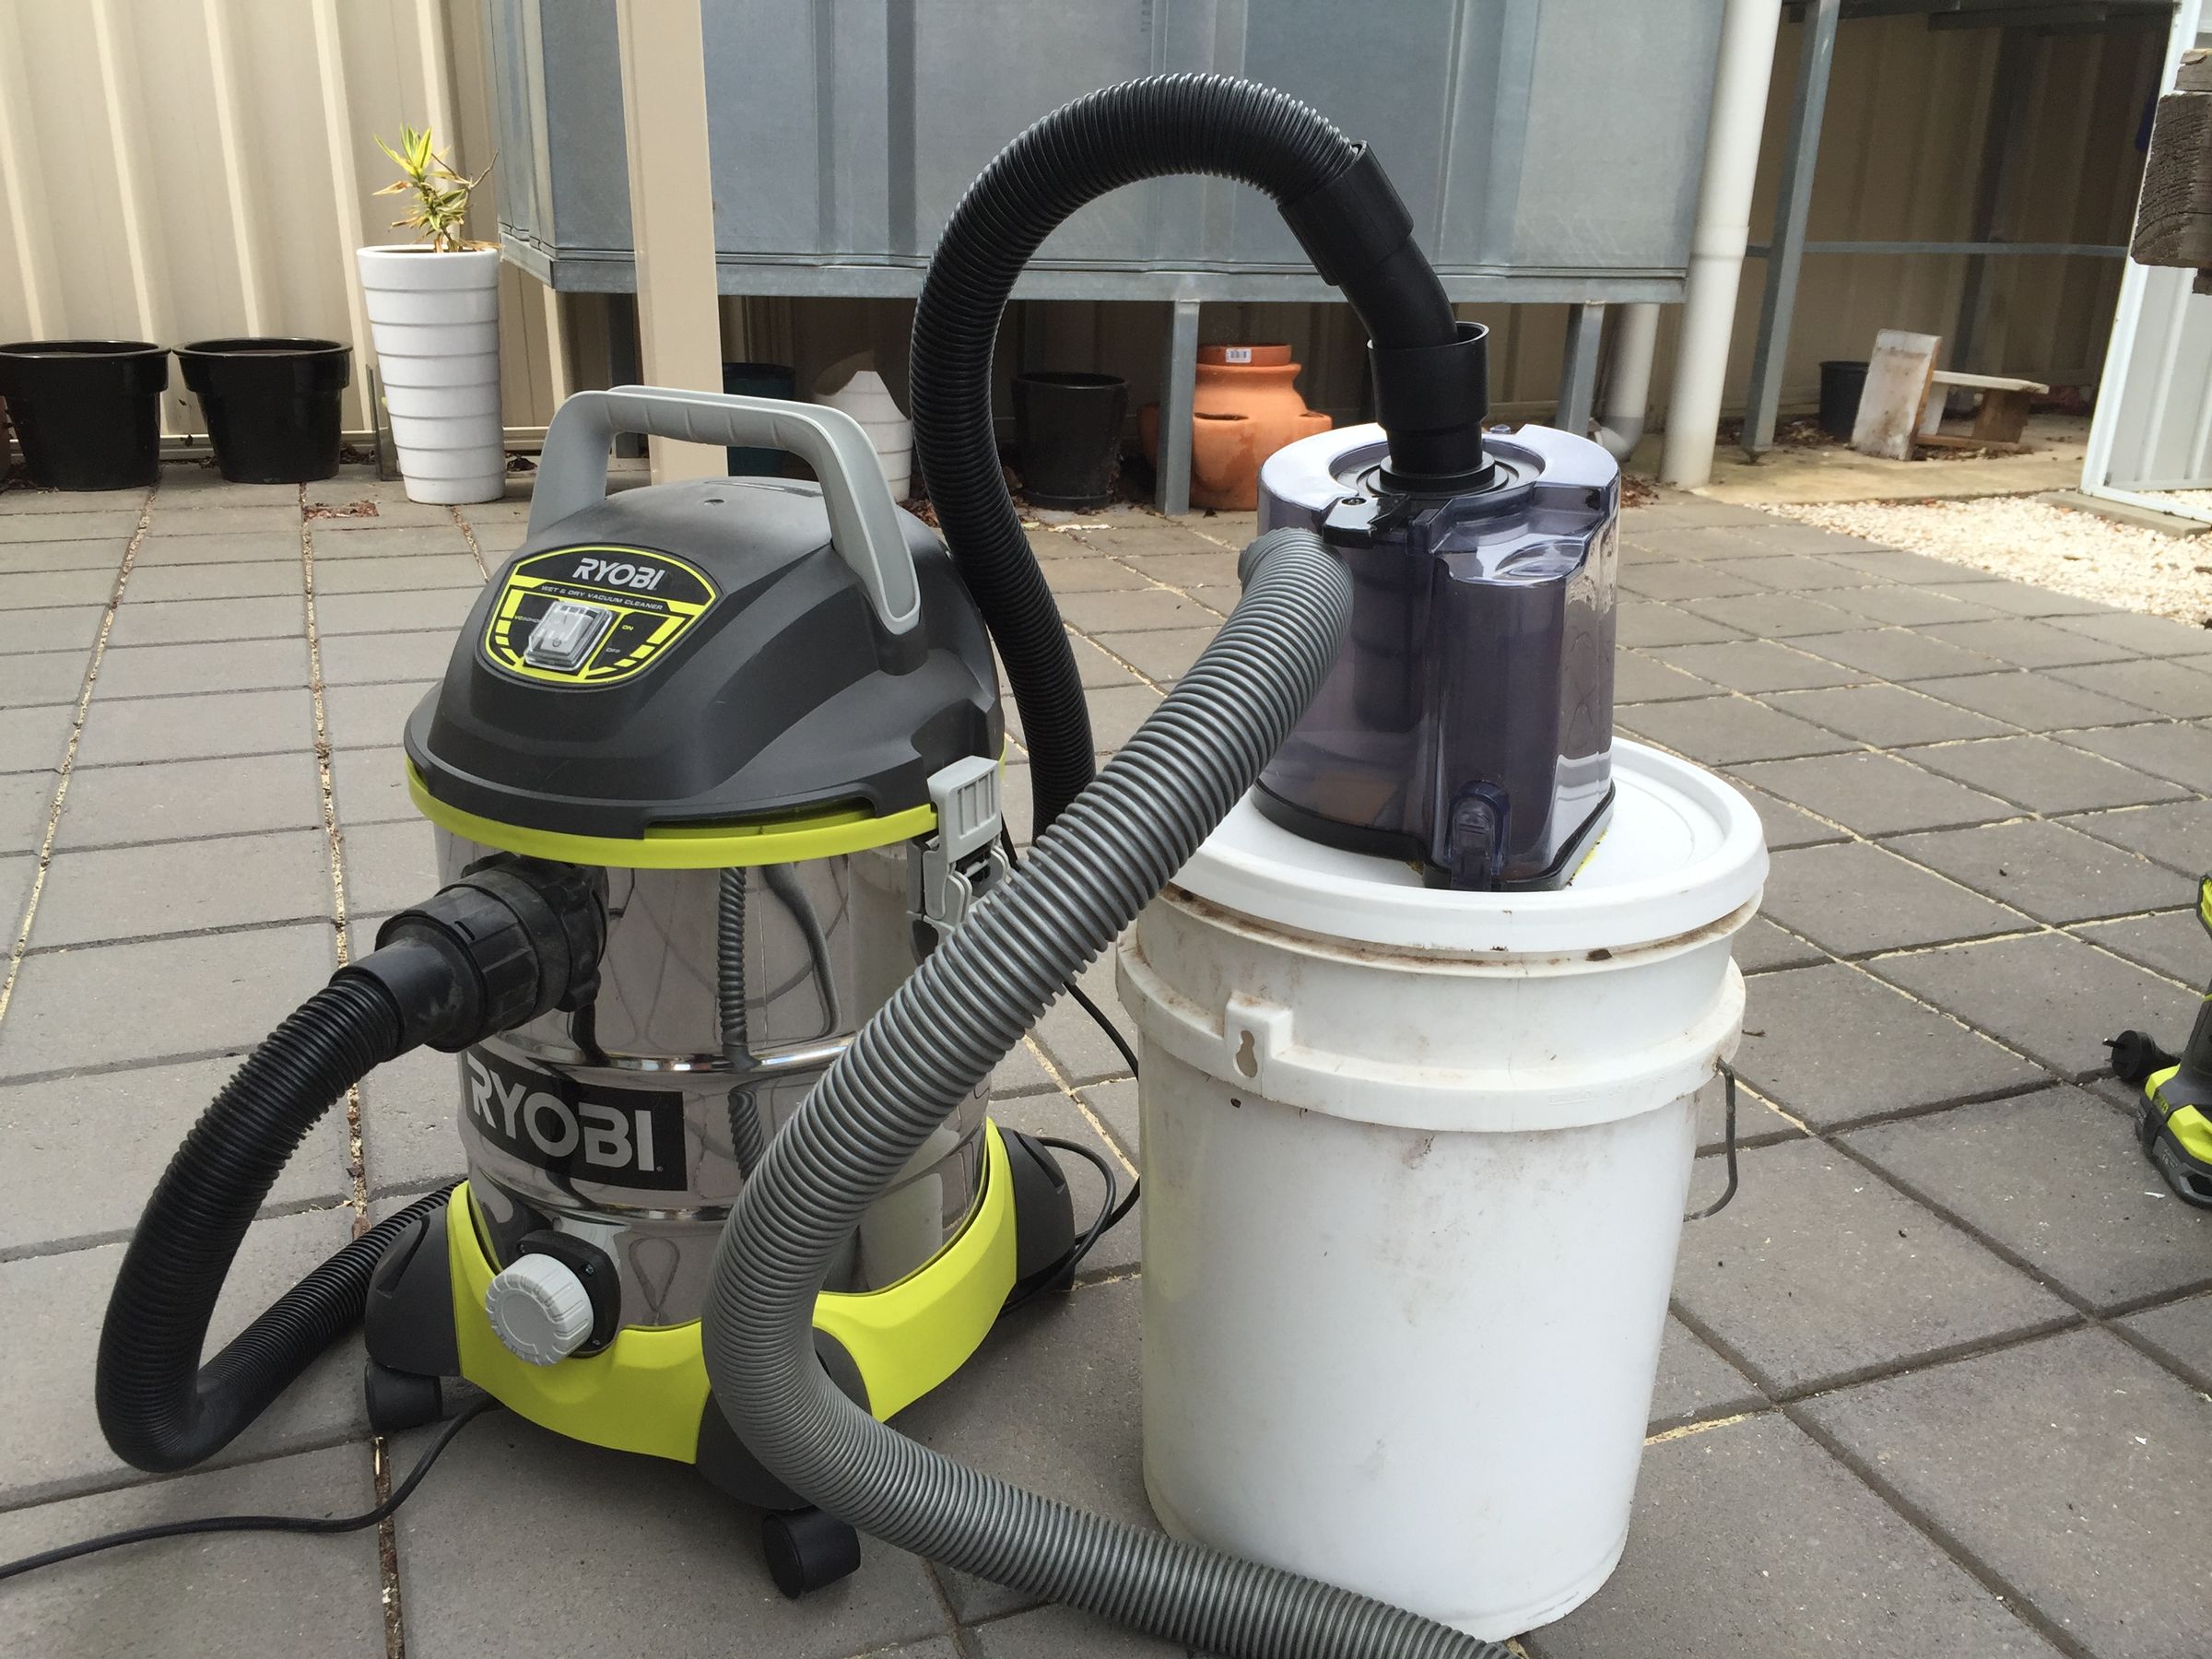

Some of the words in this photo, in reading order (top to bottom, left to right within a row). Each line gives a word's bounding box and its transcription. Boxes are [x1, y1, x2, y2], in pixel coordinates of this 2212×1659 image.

[572, 558, 665, 590] RYOBI
[588, 593, 623, 603] VACUUM
[625, 599, 664, 610] CLEANER
[467, 1051, 654, 1171] RYOBI
